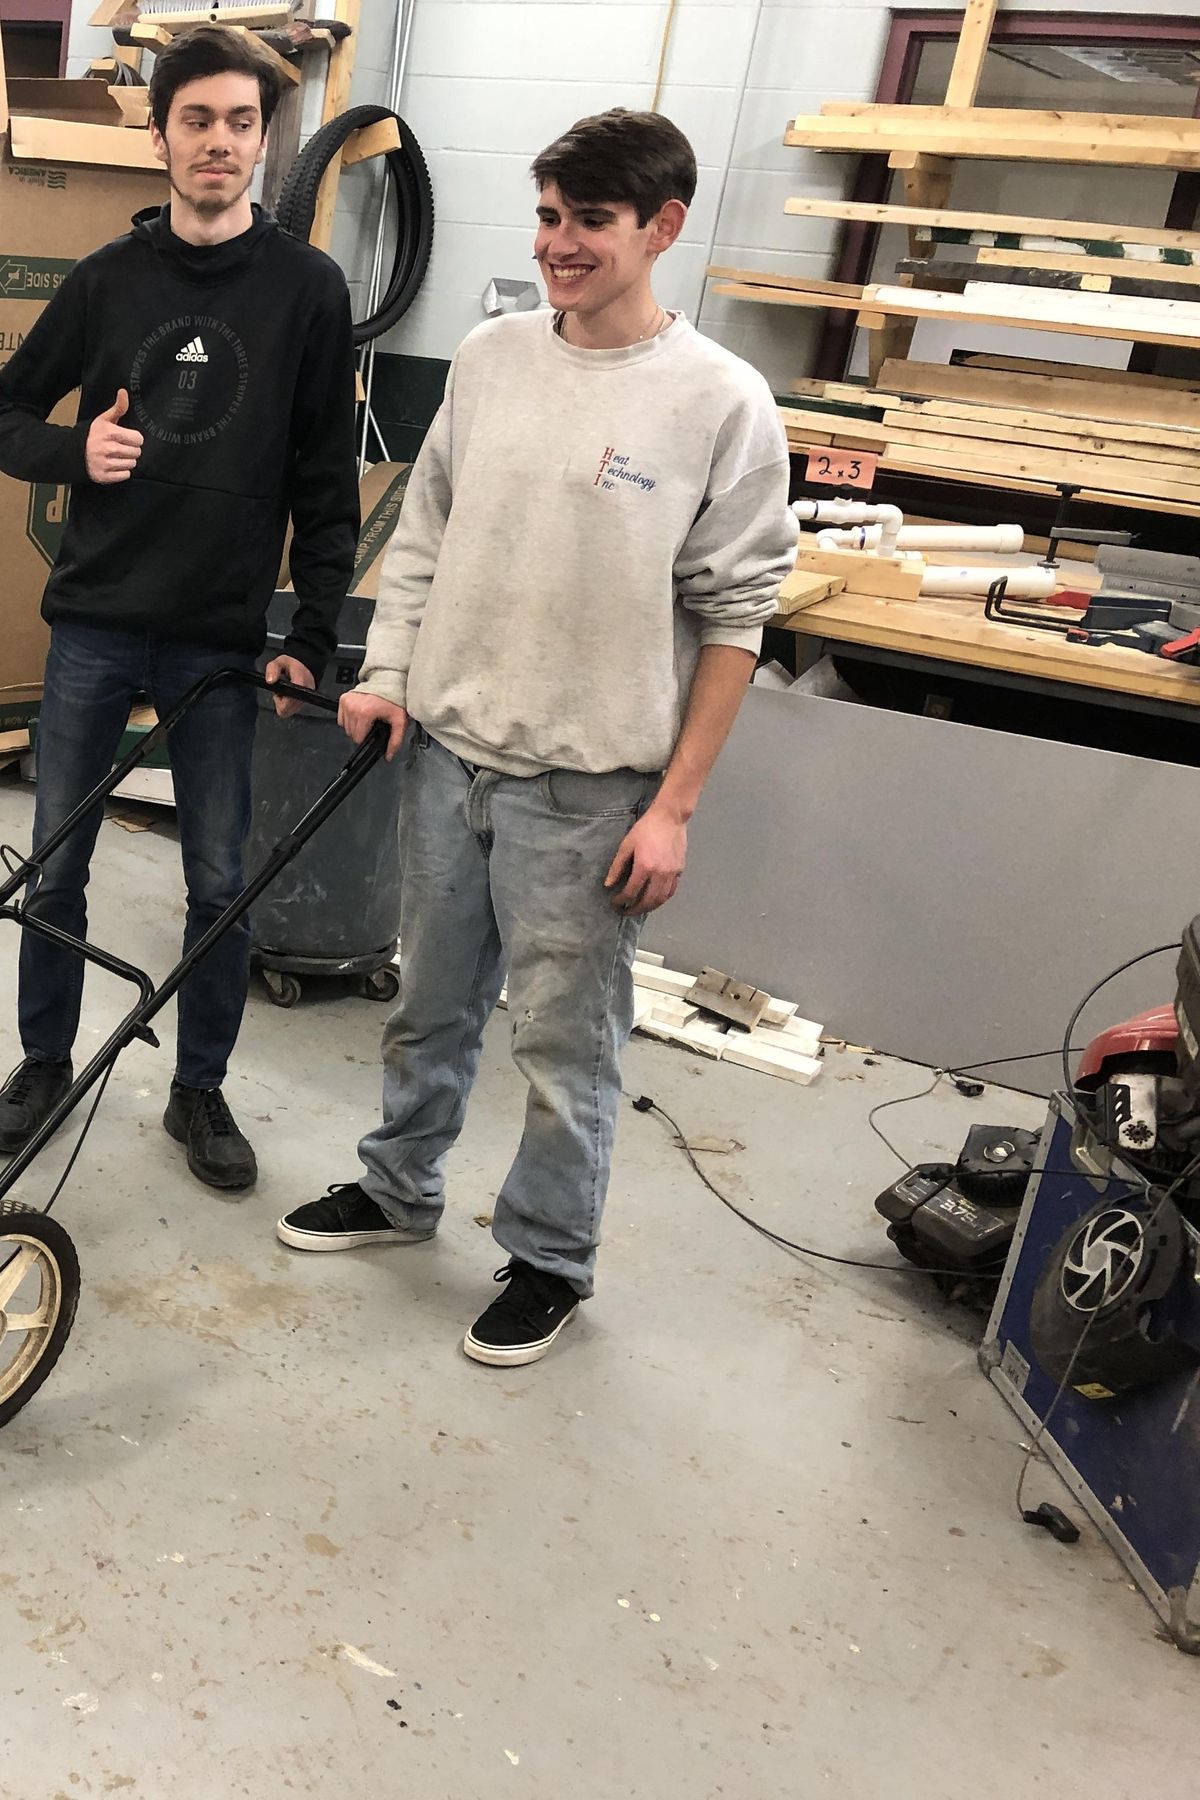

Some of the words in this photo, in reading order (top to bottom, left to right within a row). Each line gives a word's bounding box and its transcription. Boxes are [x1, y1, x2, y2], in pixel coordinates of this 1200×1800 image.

[26, 272, 51, 288] SIDE
[158, 315, 191, 336] BRAND
[194, 315, 219, 329] WITH
[218, 322, 236, 341] THE
[143, 330, 161, 350] THE
[175, 353, 209, 363] adidas
[231, 338, 249, 369] THREE
[130, 350, 148, 392] STRIPES
[178, 370, 198, 390] 03
[228, 372, 249, 414] STRIPES
[215, 414, 232, 431] THE
[184, 426, 217, 445] BRAND
[602, 446, 630, 466] Heat
[593, 473, 615, 490] Inc
[599, 459, 656, 491] Technology
[363, 520, 387, 542] FROM
[378, 502, 398, 519] THIS
